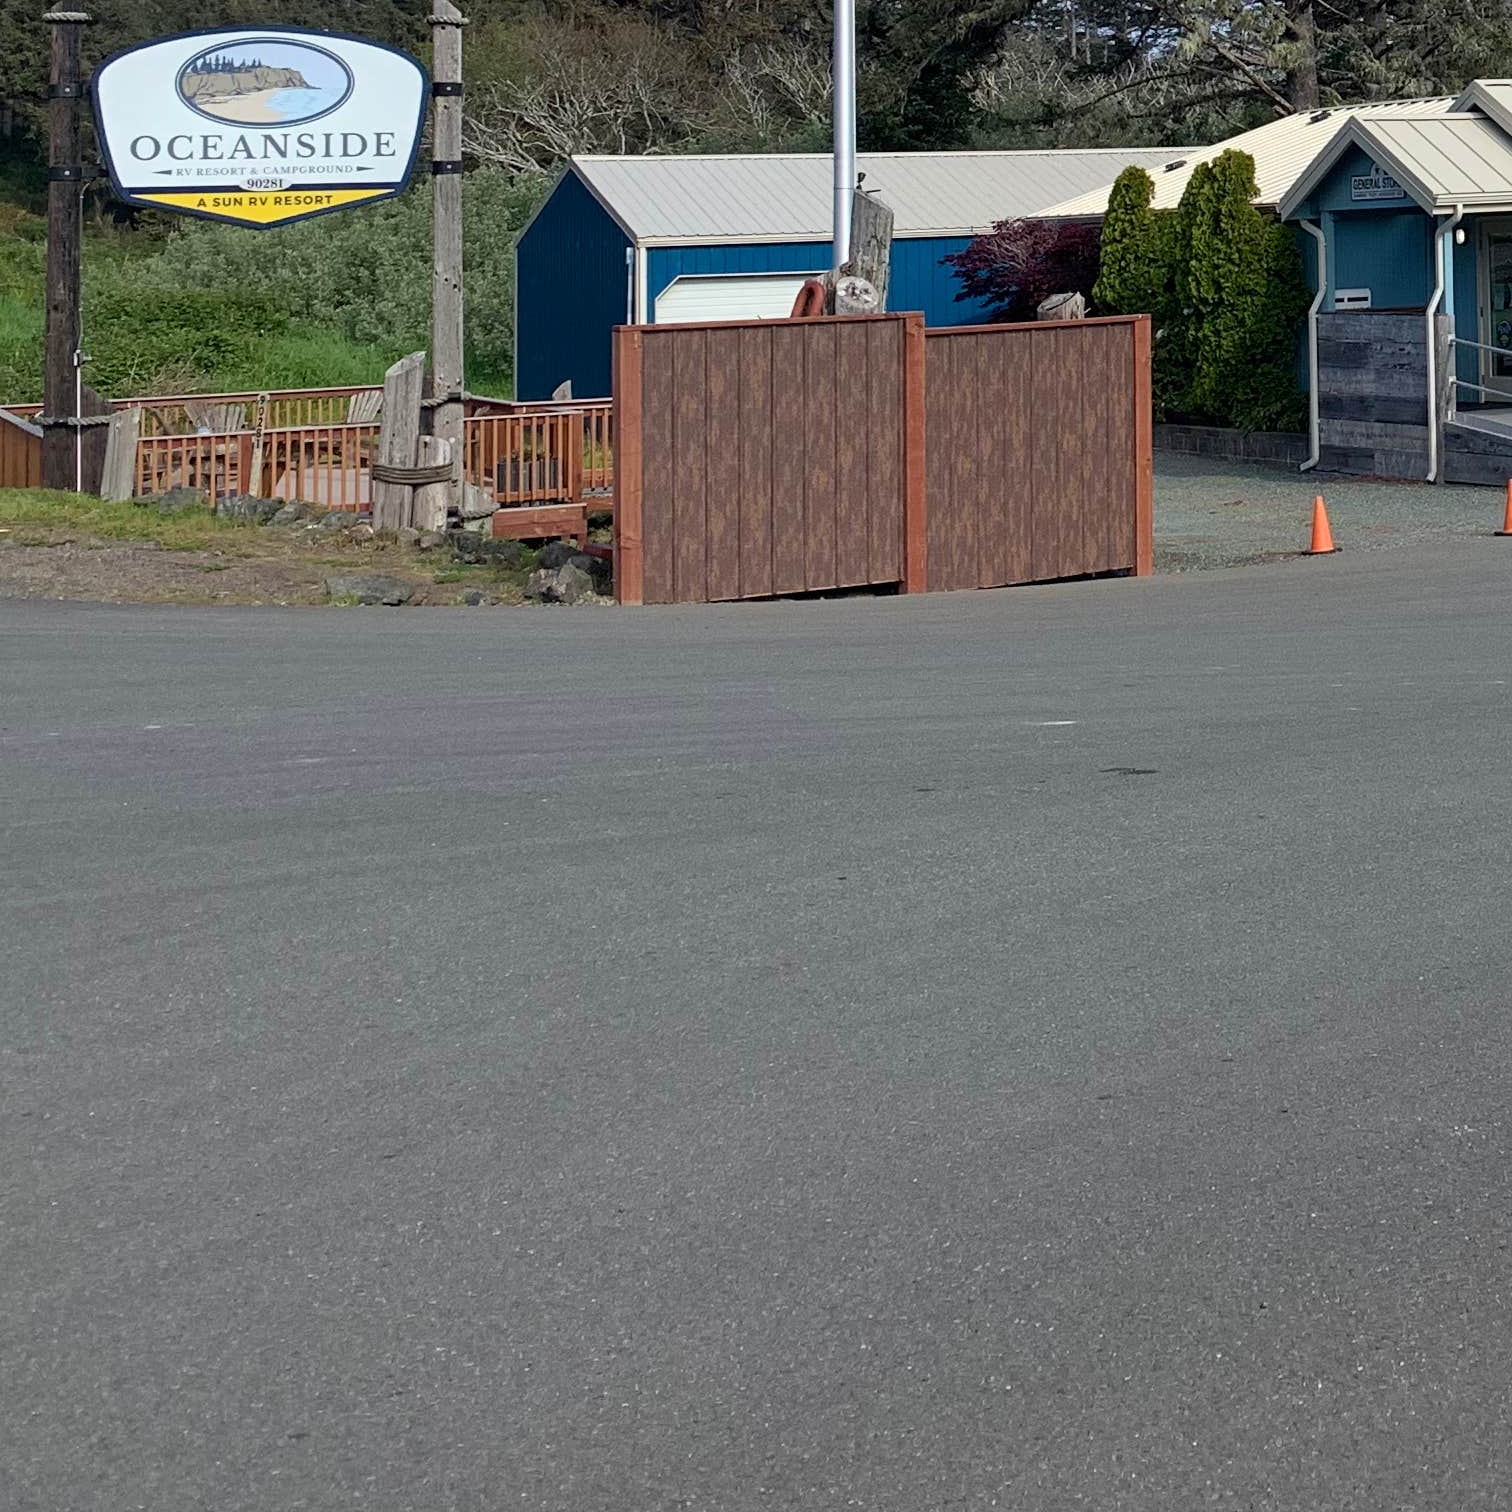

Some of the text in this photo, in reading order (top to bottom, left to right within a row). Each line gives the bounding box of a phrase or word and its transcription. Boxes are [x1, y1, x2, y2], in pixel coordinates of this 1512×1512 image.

[129, 131, 397, 162] OCEANSIDE
[176, 164, 353, 176] RV RESORT & CAMPGROUND
[246, 178, 284, 189] 90281
[1353, 177, 1401, 190] GENERAL STO
[196, 194, 333, 207] A SUN RV RESORT
[256, 395, 266, 449] 90281
